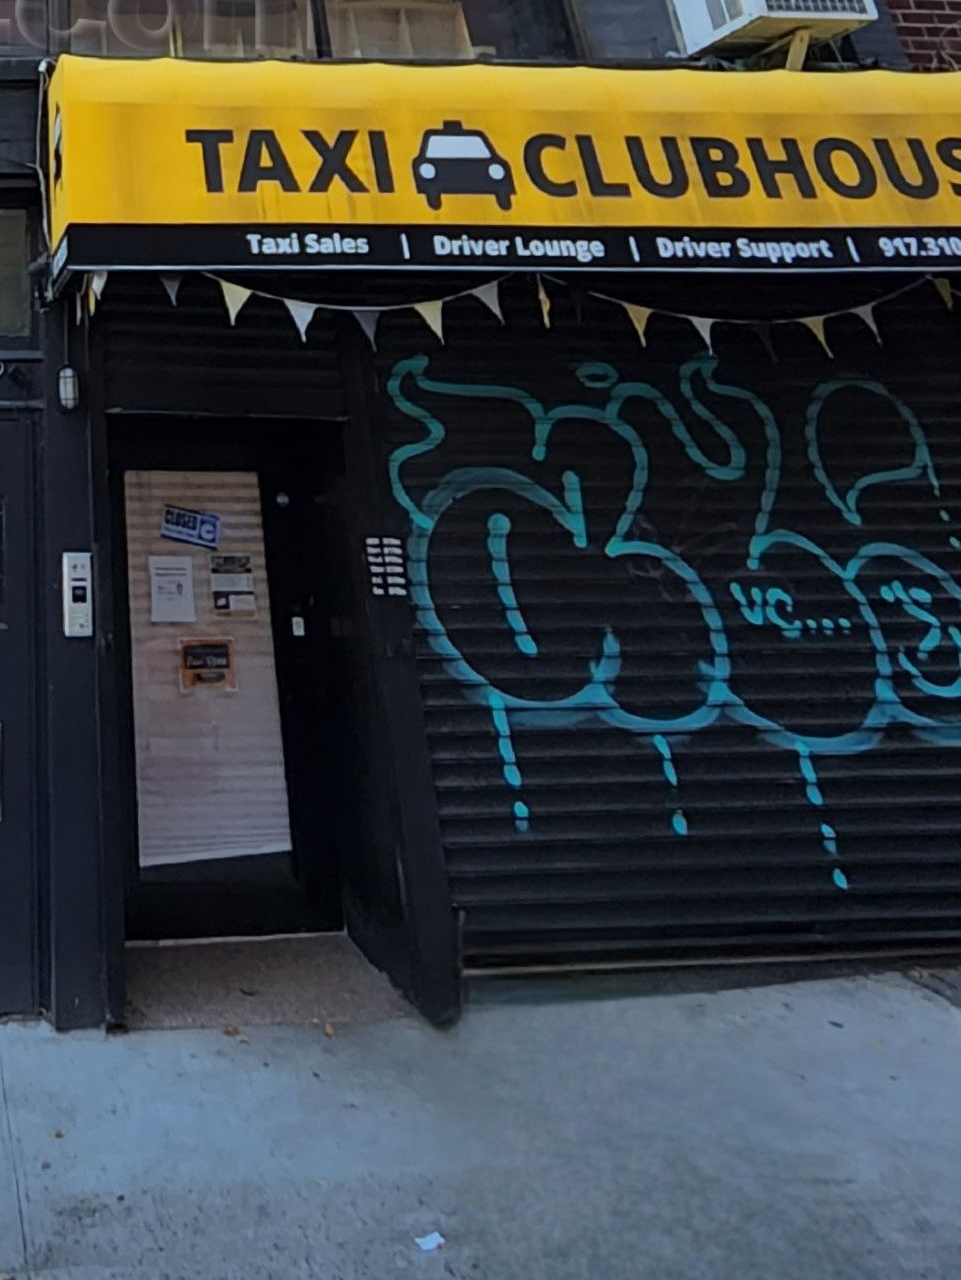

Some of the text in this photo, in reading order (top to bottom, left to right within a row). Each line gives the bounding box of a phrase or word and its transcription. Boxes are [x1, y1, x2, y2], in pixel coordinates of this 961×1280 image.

[185, 129, 394, 193] TAXI
[246, 232, 300, 255] Taxi
[304, 232, 370, 255] Sales
[433, 234, 510, 257] Driver
[515, 236, 605, 263] Lounge
[656, 236, 731, 259] Driver
[736, 238, 833, 263] Support
